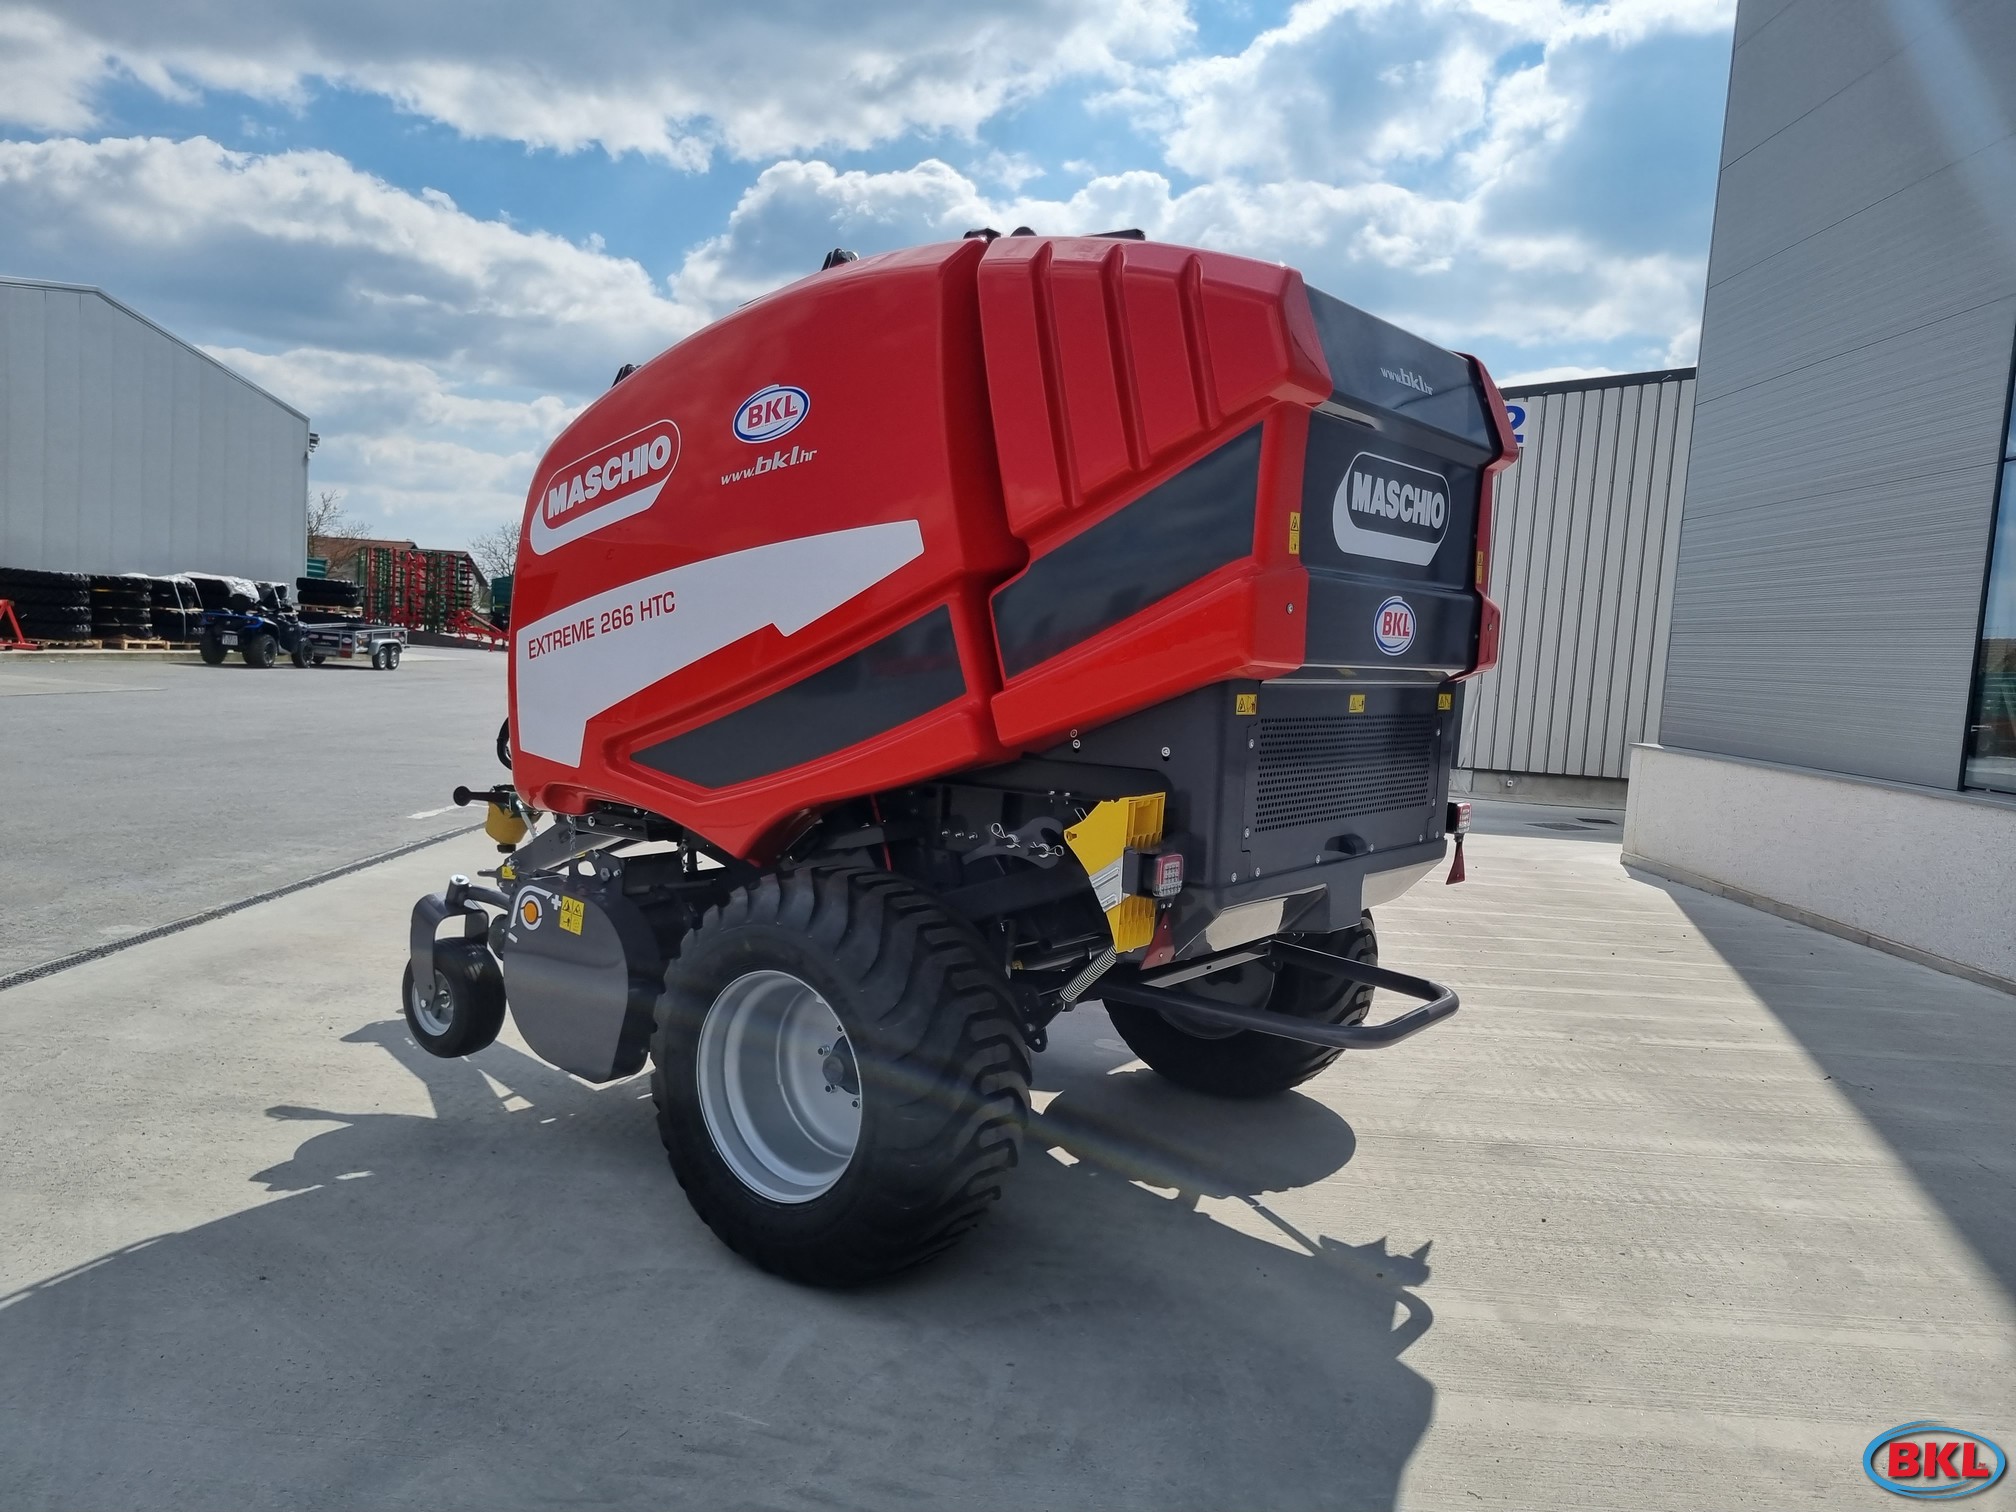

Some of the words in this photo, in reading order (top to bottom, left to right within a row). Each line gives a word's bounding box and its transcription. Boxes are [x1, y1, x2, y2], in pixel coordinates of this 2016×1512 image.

[747, 394, 798, 429] BKL
[547, 434, 671, 519] MASCHIO
[720, 445, 818, 486] www.bkl.hr
[1351, 471, 1445, 529] MASCHIO
[527, 616, 596, 660] EXTREME
[600, 603, 635, 633] 266
[639, 591, 676, 621] HTC
[1382, 611, 1410, 637] BKL
